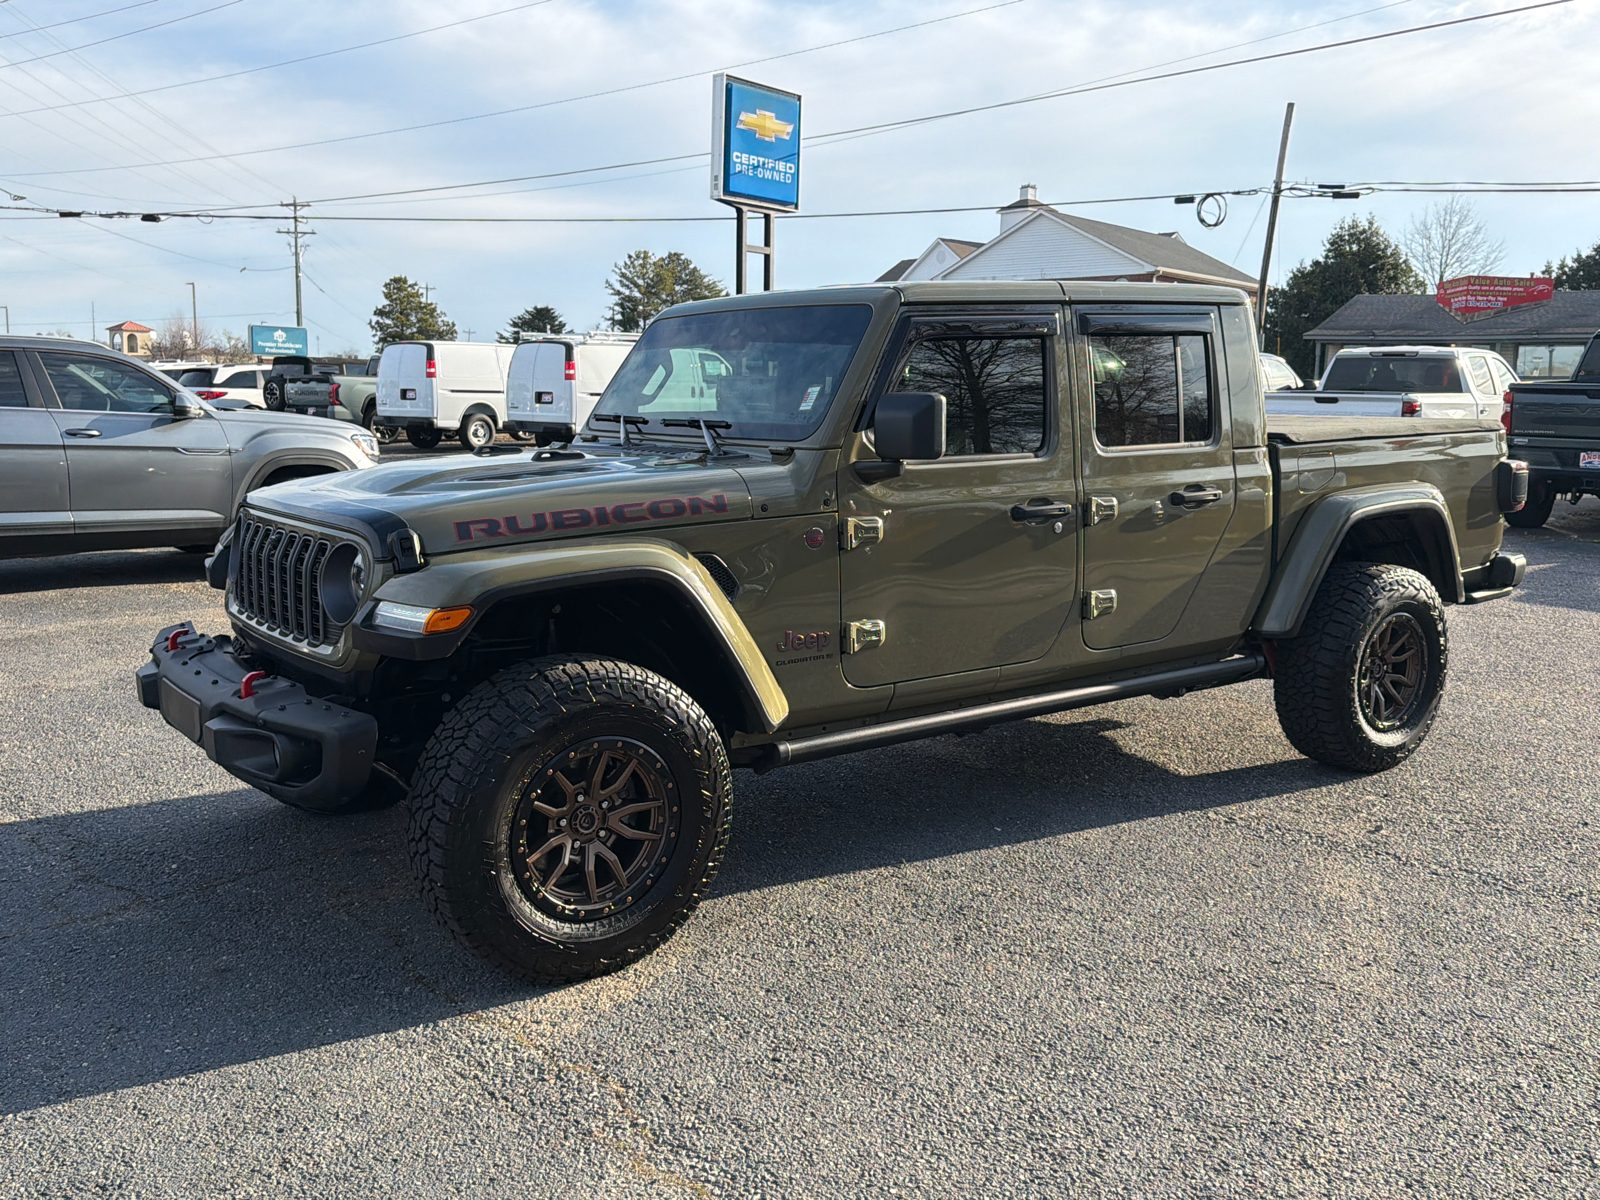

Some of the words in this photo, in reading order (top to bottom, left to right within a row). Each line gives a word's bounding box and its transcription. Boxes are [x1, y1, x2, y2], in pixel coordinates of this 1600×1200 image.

[733, 151, 795, 174] CERTIFIED
[735, 164, 792, 183] PRE-OWNED
[1470, 277, 1491, 285] Value
[1494, 278, 1511, 286] Auto
[1514, 279, 1535, 287] Sales
[453, 494, 729, 542] RUBICON
[776, 630, 830, 653] Jeep
[775, 654, 825, 667] GLADIATOR
